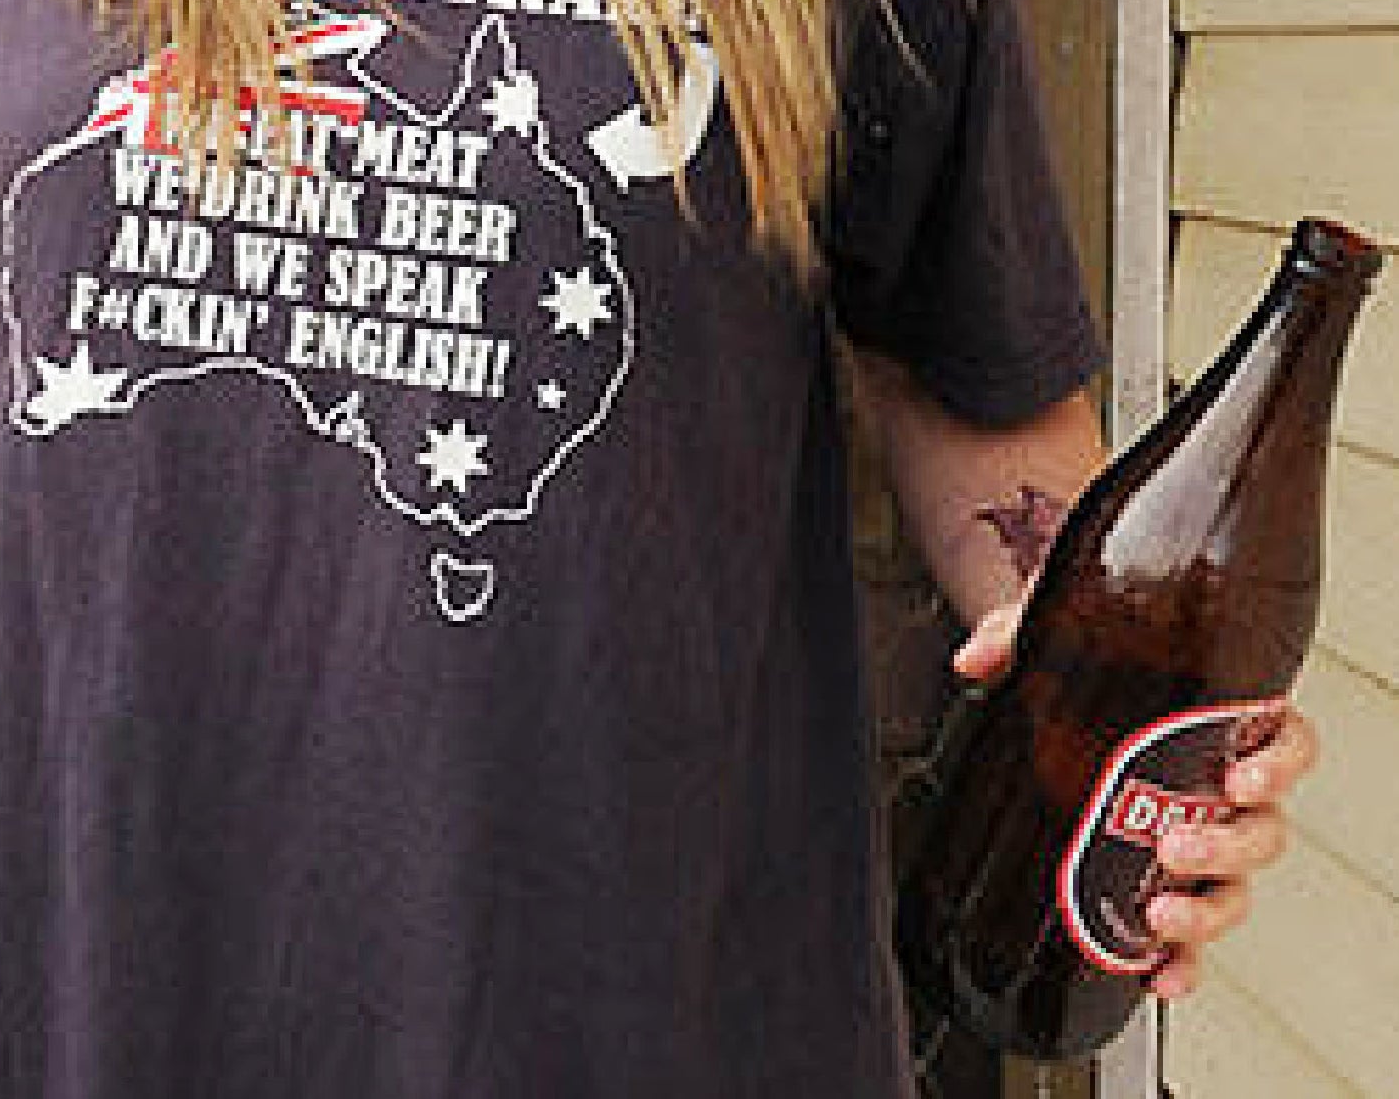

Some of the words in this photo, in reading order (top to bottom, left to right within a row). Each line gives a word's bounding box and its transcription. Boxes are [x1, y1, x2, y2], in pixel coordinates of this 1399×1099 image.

[113, 147, 183, 211] WE
[199, 161, 367, 239] DRINK
[381, 193, 519, 265] BEER
[352, 123, 490, 190] MEAT
[108, 214, 214, 281] AND
[231, 231, 311, 299] WE
[324, 245, 490, 325] SPEAK
[67, 271, 270, 354] F#CKIN'
[290, 308, 512, 399] ENGLISH!
